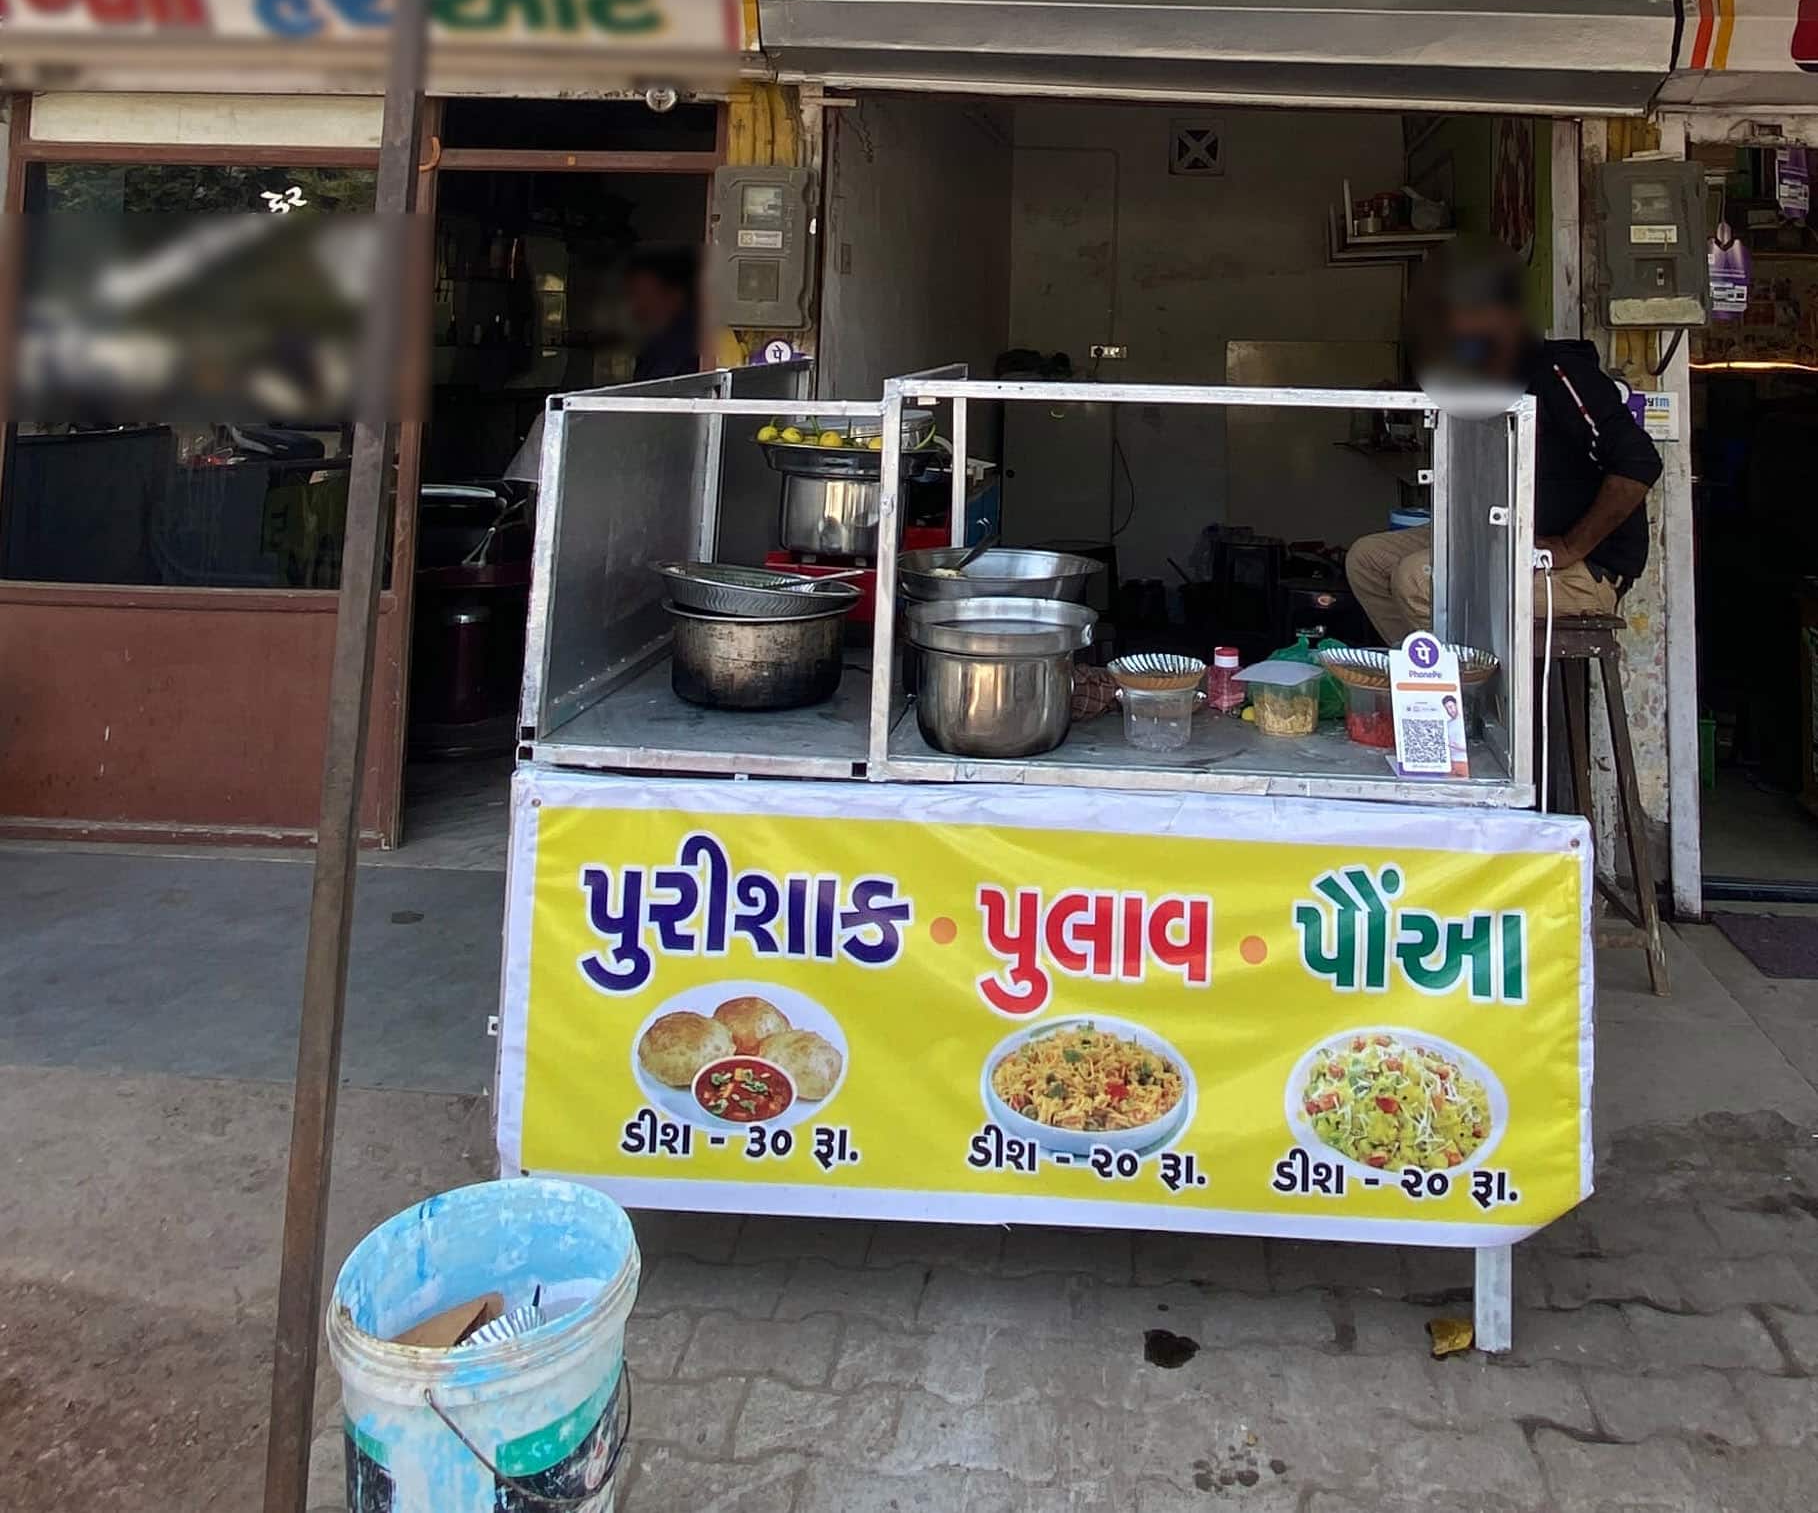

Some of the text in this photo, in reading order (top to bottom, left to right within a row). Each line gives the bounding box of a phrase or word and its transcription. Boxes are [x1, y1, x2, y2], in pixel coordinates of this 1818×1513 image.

[582, 835, 1523, 1014] પુરીશાક પુલાવ પૌંઆ
[621, 1108, 691, 1155] ડીશ
[745, 1126, 793, 1158] ૩૦
[967, 1125, 1038, 1172] ડીશ
[1091, 1148, 1139, 1178] ૨૦
[1272, 1148, 1344, 1195] ડીશ
[1400, 1167, 1449, 1198] ૨૦
